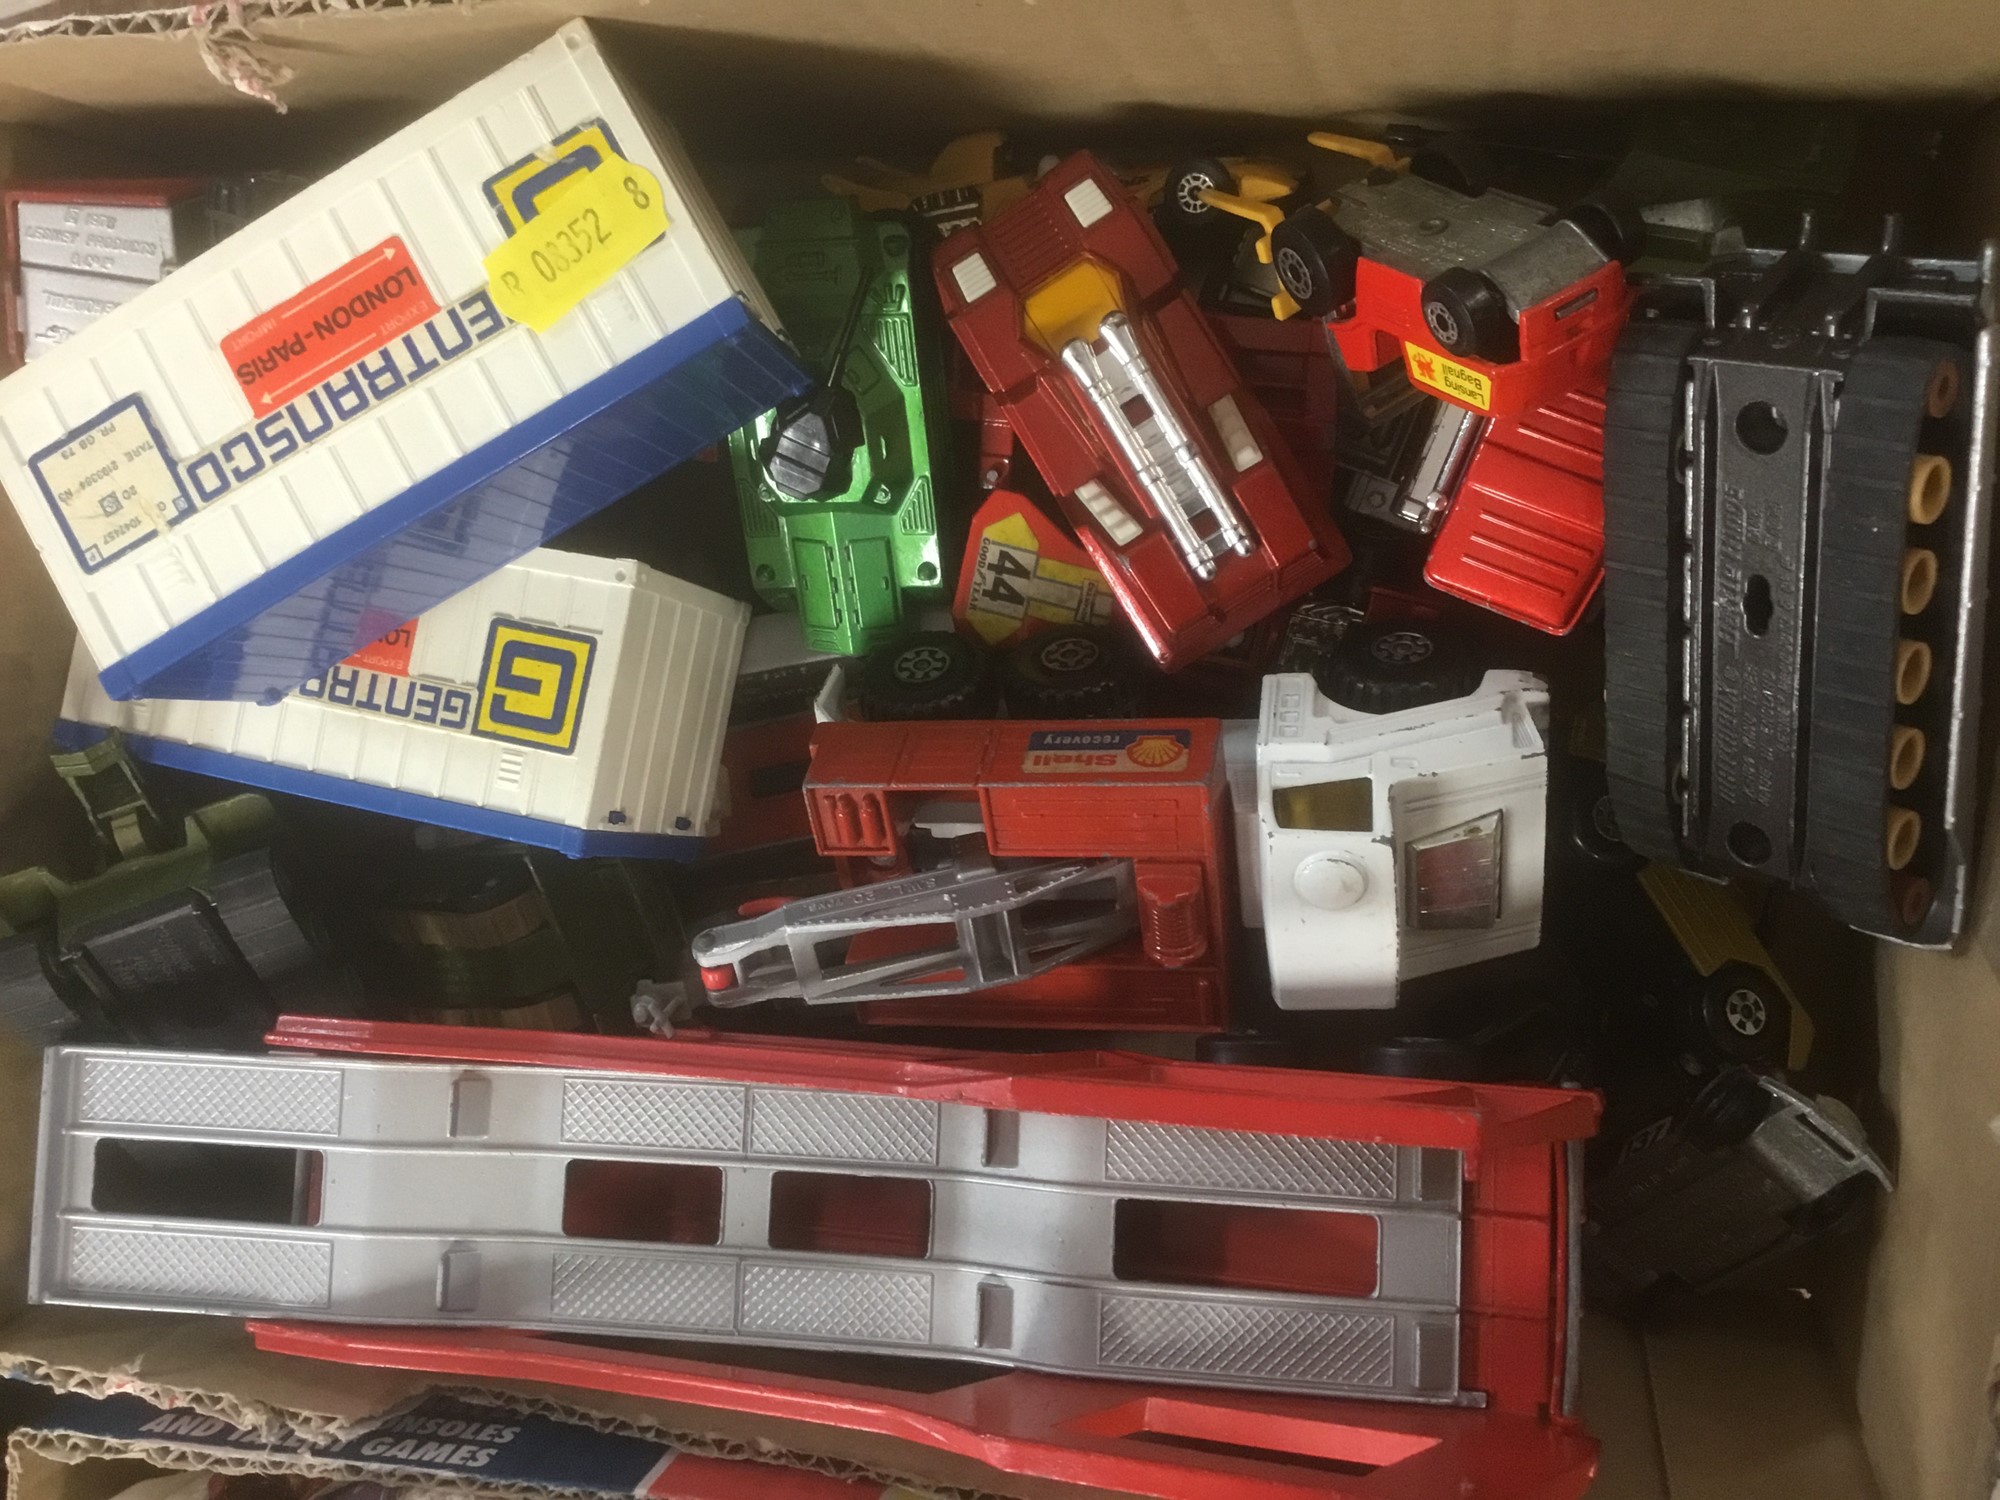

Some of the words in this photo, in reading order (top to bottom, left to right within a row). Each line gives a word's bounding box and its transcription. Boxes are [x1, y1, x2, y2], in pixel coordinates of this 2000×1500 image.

[623, 176, 650, 209] 8
[500, 271, 525, 295] R
[531, 208, 612, 282] 08352
[231, 318, 277, 352] IMPORT
[236, 266, 418, 386] LONDON-PARIS
[377, 300, 429, 338] EXPORT
[1441, 363, 1483, 391] Bagnall
[1444, 376, 1485, 406] Lansing
[186, 289, 512, 504] ENTRANSCO
[124, 440, 154, 463] TARE
[981, 549, 1031, 606] 44
[363, 656, 405, 671] EXPORT
[1043, 734, 1120, 744] recovery
[1032, 753, 1118, 767] Shell
[138, 1412, 225, 1437] AND
[360, 1436, 498, 1467] GAMES
[383, 1414, 521, 1444] NSOLES
